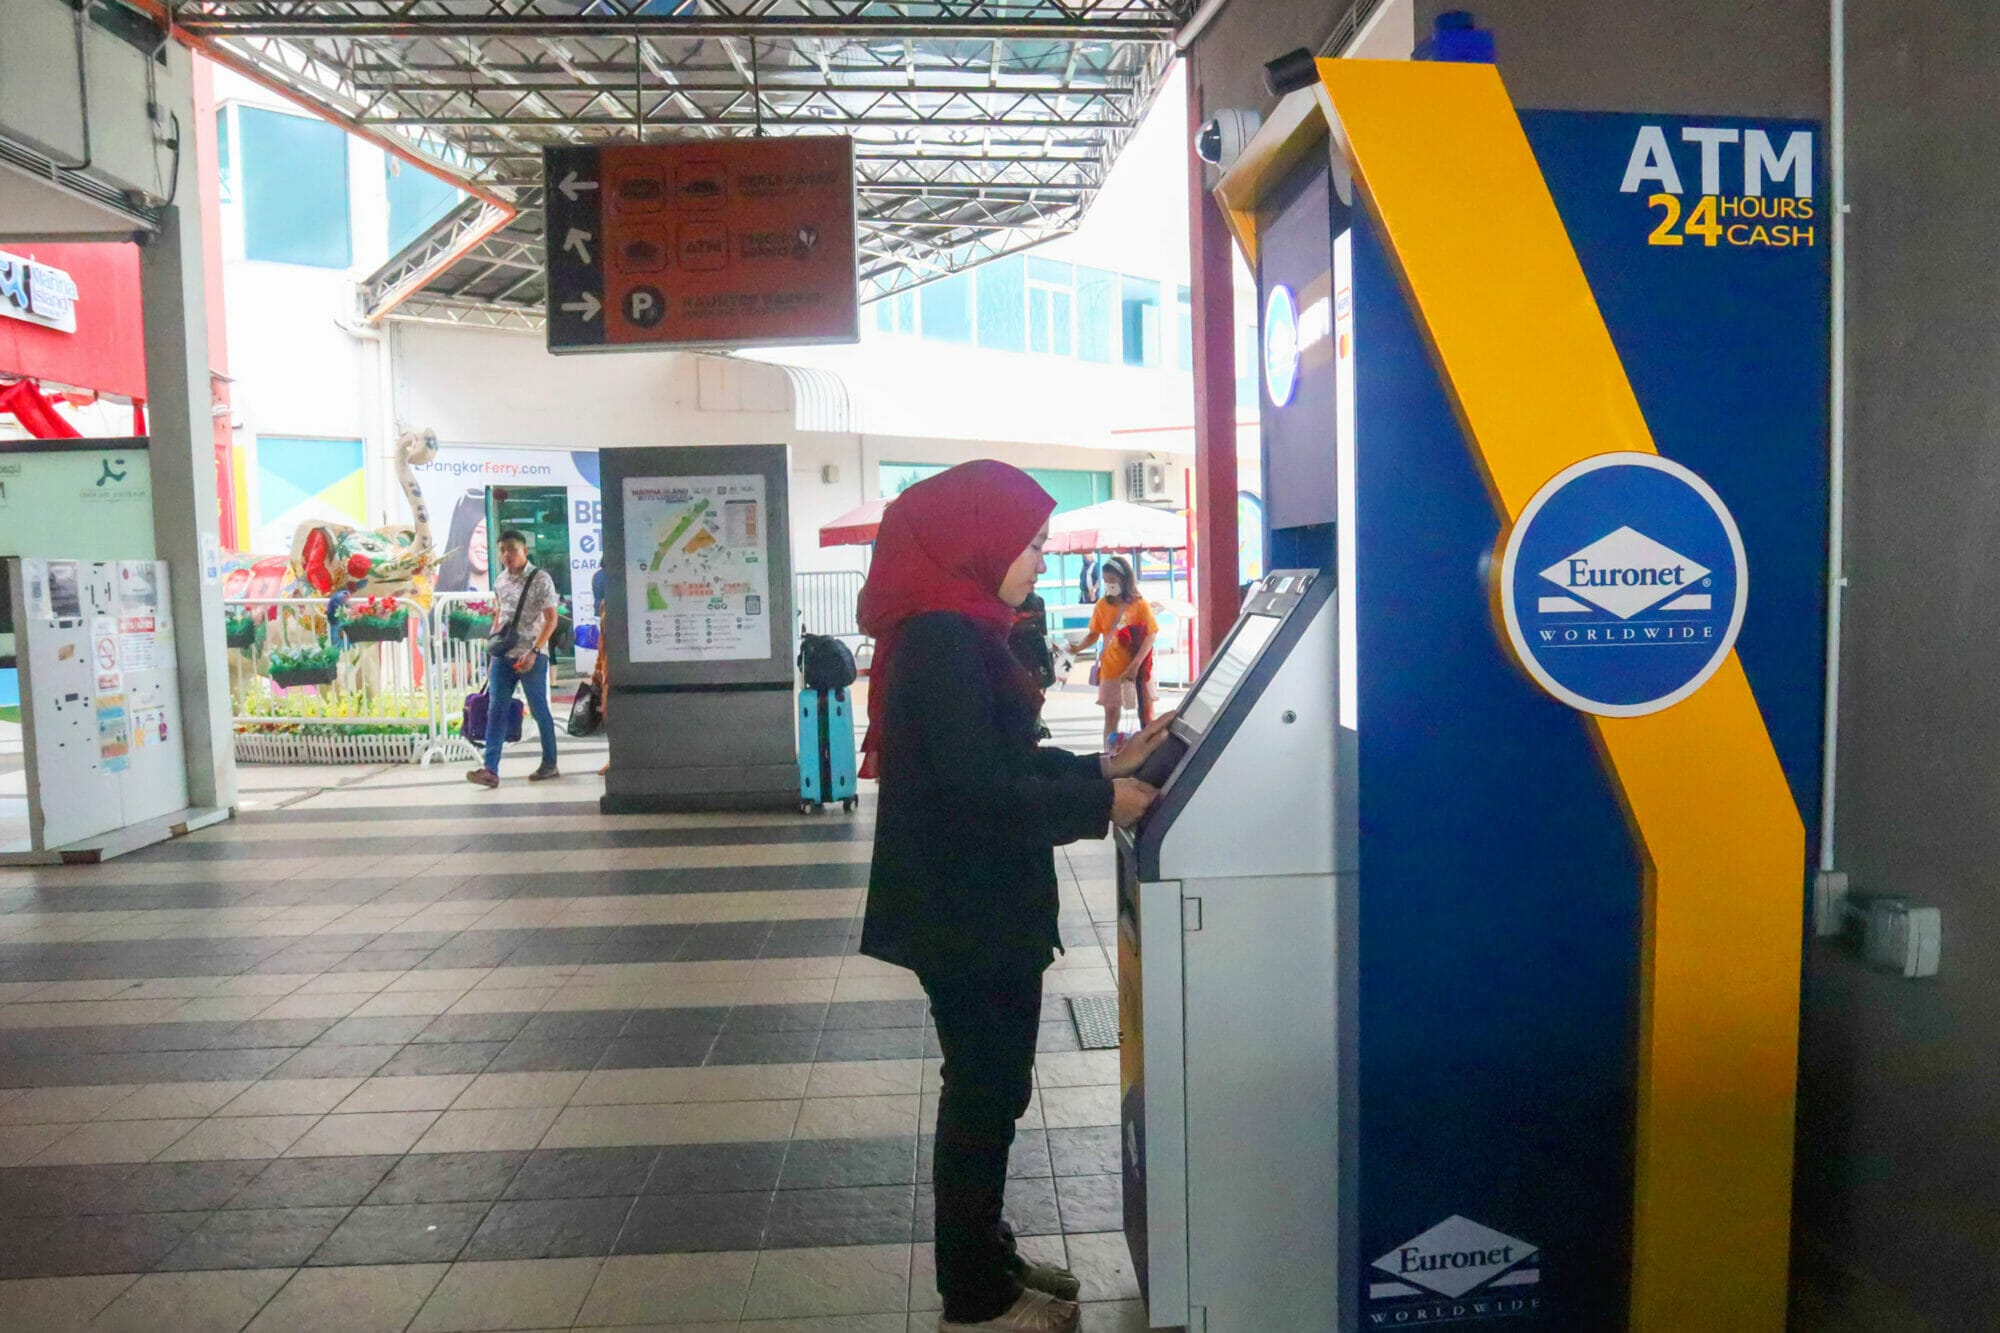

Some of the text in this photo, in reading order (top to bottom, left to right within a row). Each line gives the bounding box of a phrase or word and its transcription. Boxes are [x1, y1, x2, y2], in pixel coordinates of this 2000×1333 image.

[1619, 125, 1813, 198] ATM
[1647, 193, 1814, 247] 24 HOURS
[1726, 225, 1815, 247] CASH
[632, 292, 652, 319] P
[1566, 559, 1686, 587] Euronet
[1539, 626, 1713, 641] WORLDWIDE
[1398, 1244, 1515, 1274] Euronet
[1370, 1298, 1541, 1325] WORLDWIDE
